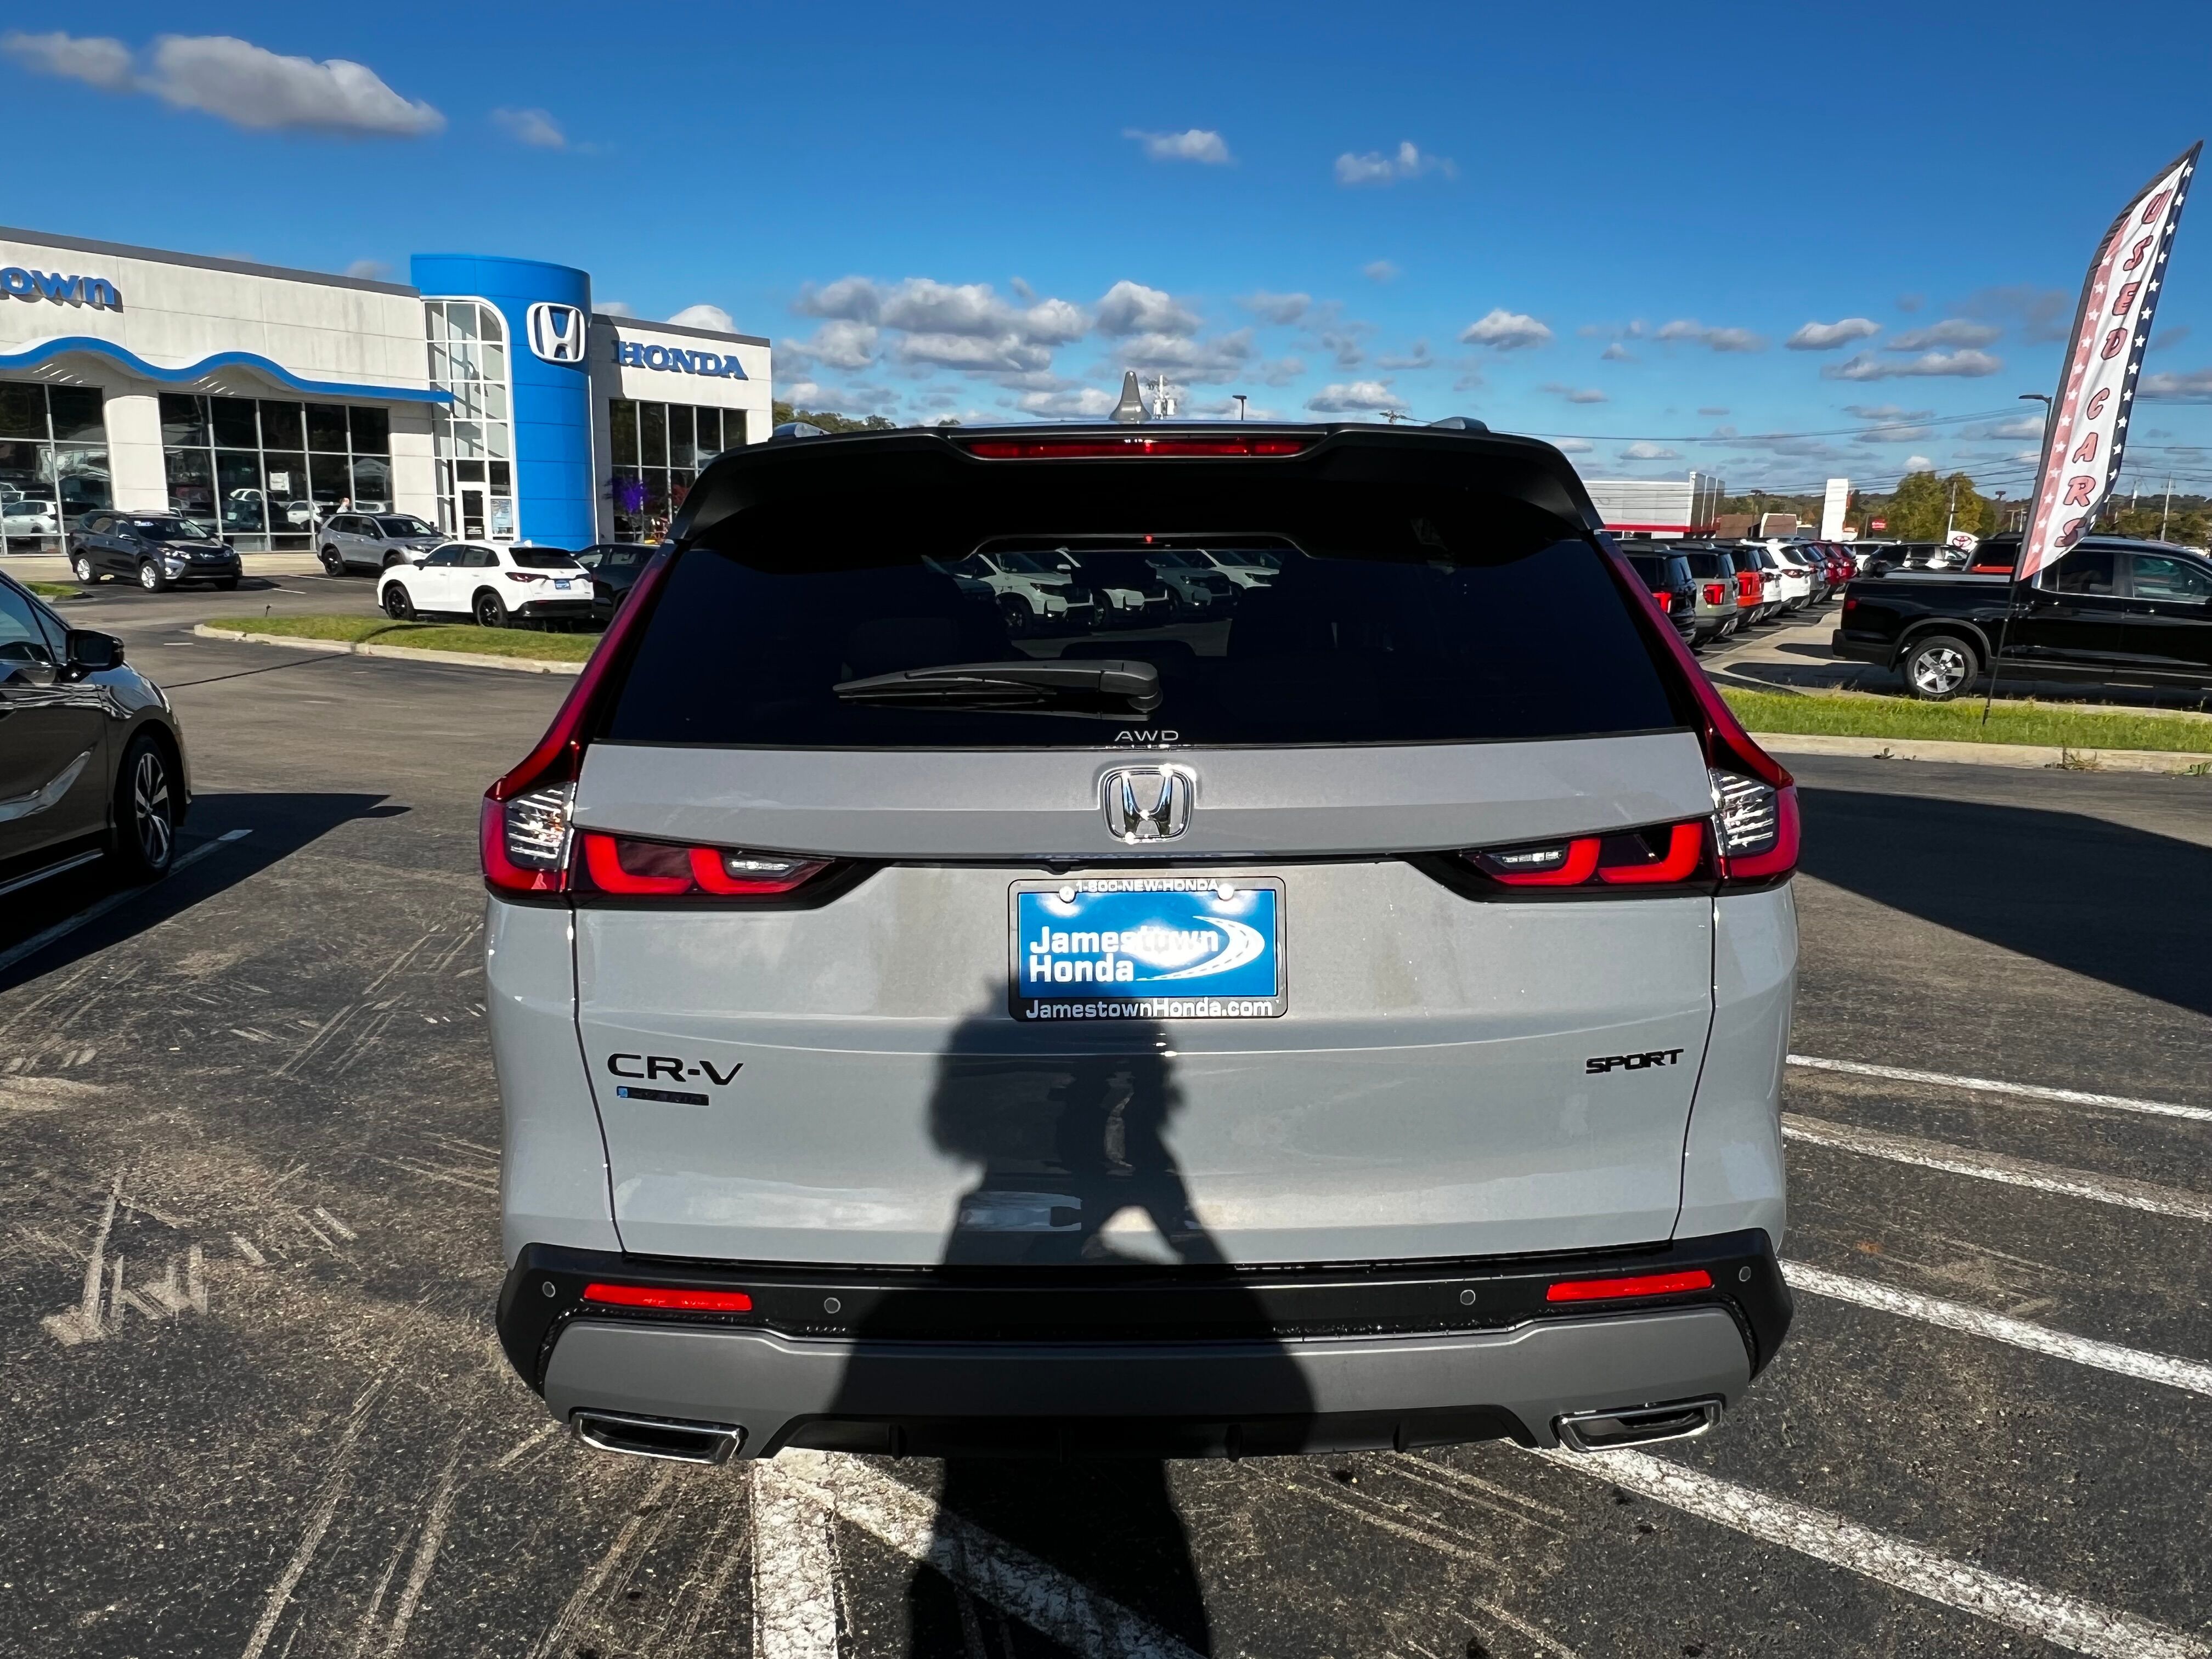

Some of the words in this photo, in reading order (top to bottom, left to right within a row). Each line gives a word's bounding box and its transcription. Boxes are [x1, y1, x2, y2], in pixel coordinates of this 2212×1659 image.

[0, 267, 116, 305] own
[2102, 189, 2172, 360] USED
[618, 341, 749, 380] HONDA
[2054, 387, 2110, 548] CARS
[1114, 730, 1179, 742] AWD
[1076, 879, 1219, 892] 1-800-NEW-HONDA
[1030, 926, 1218, 953] Jamestown
[1030, 952, 1134, 982] Honda
[1025, 997, 1273, 1018] JamestownHonda.com
[607, 1053, 743, 1085] CR-V
[1586, 1048, 1684, 1074] SPORT
